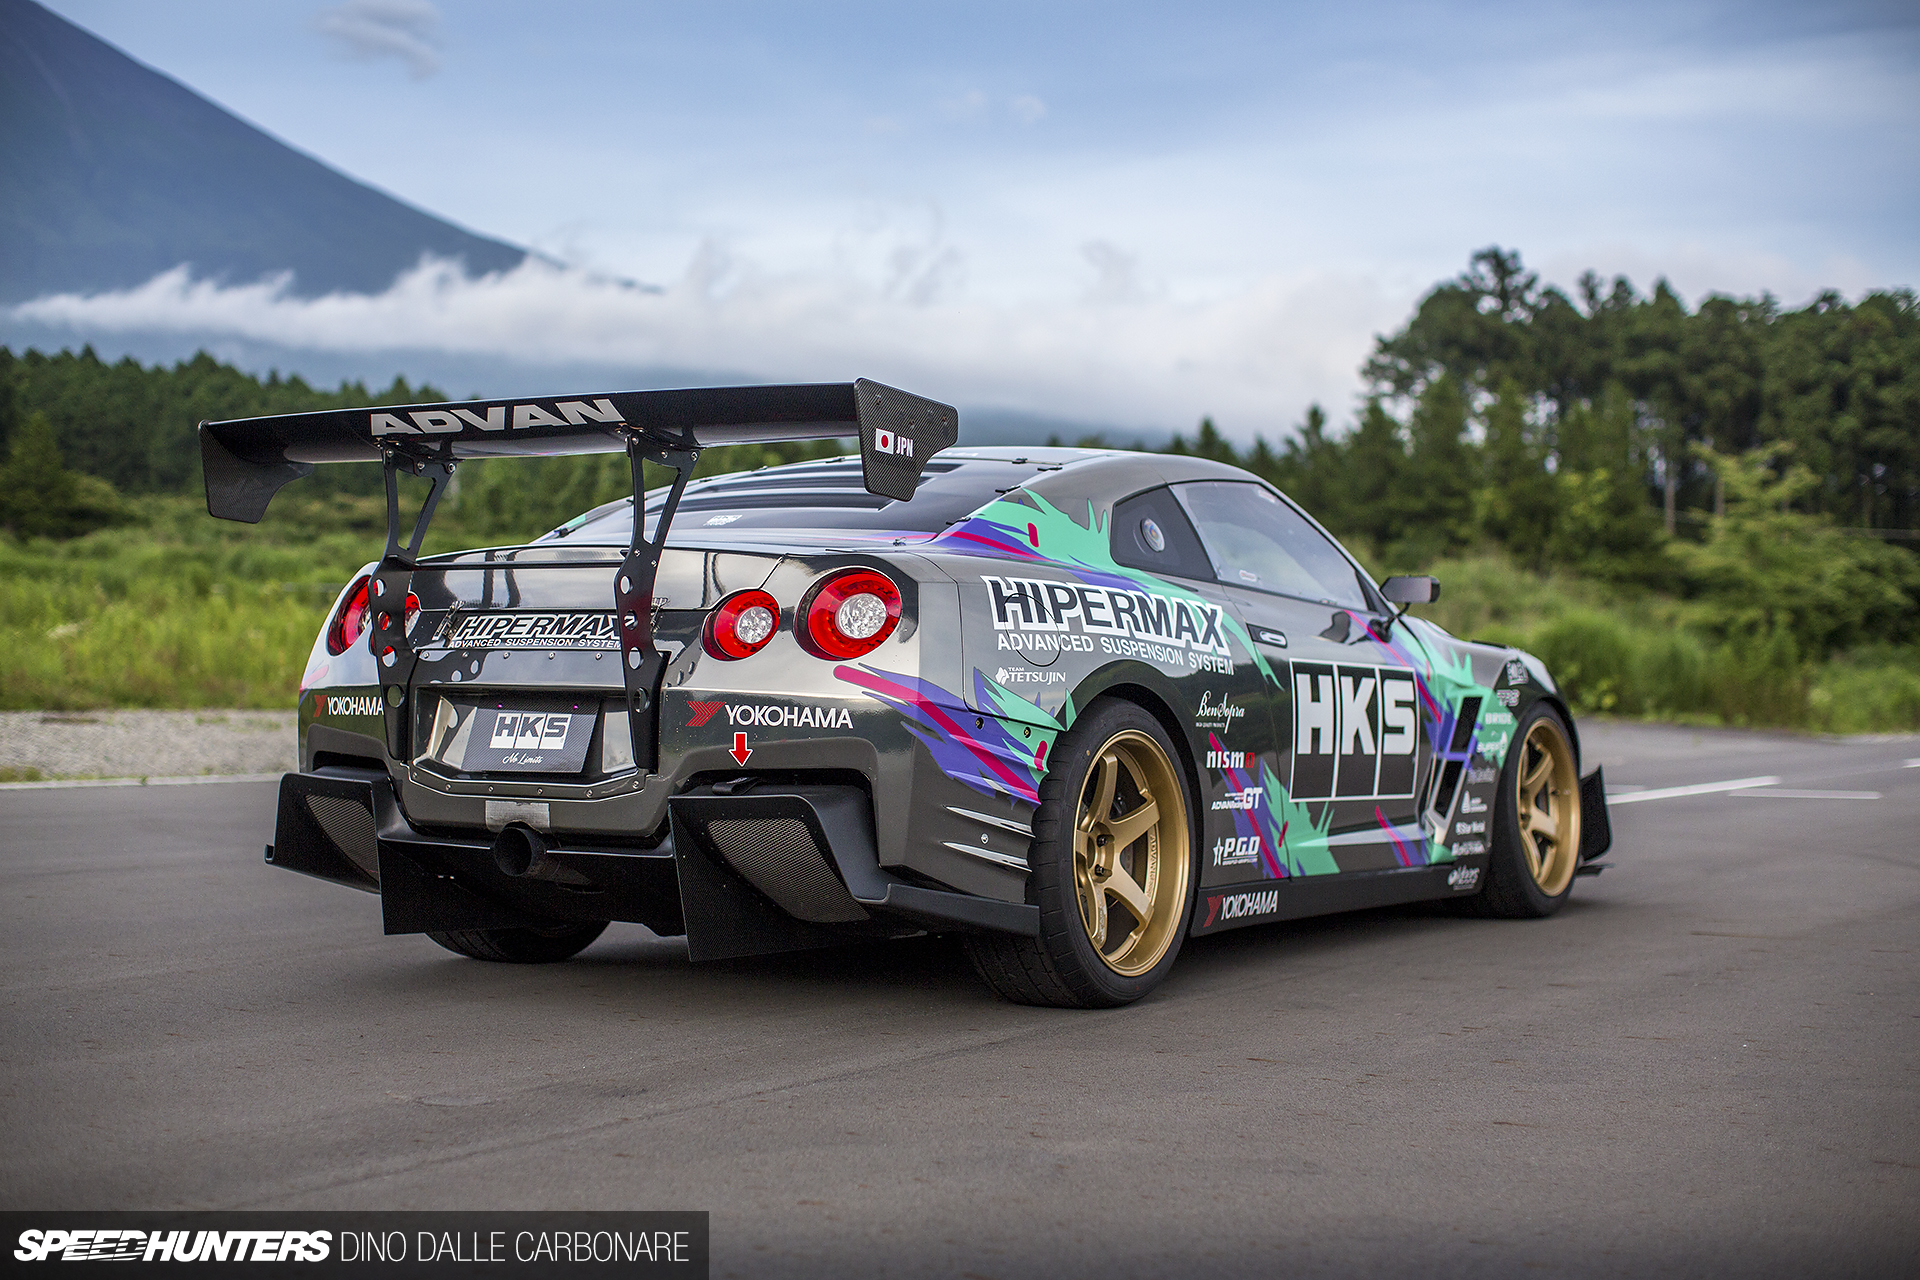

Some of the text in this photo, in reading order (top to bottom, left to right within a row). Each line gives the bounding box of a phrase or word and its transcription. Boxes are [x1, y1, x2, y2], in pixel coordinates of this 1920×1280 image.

[370, 398, 626, 436] ADVAN
[896, 435, 914, 458] JPN
[979, 575, 1232, 657] HIPERMAX
[448, 638, 502, 649] ADVANCED
[505, 638, 574, 648] SUSPENSION
[998, 632, 1235, 676] ADVANCED SUSPENSION SYSTEM
[1009, 671, 1066, 686] TETSUJIN
[327, 696, 385, 716] YOKOHAMA
[725, 704, 854, 729] YOKOHAMA
[1296, 673, 1416, 755] HKS
[494, 716, 570, 739] HKS
[1206, 750, 1256, 769] nismo
[1243, 787, 1263, 810] GT
[1220, 890, 1279, 921] YOKOHAMA
